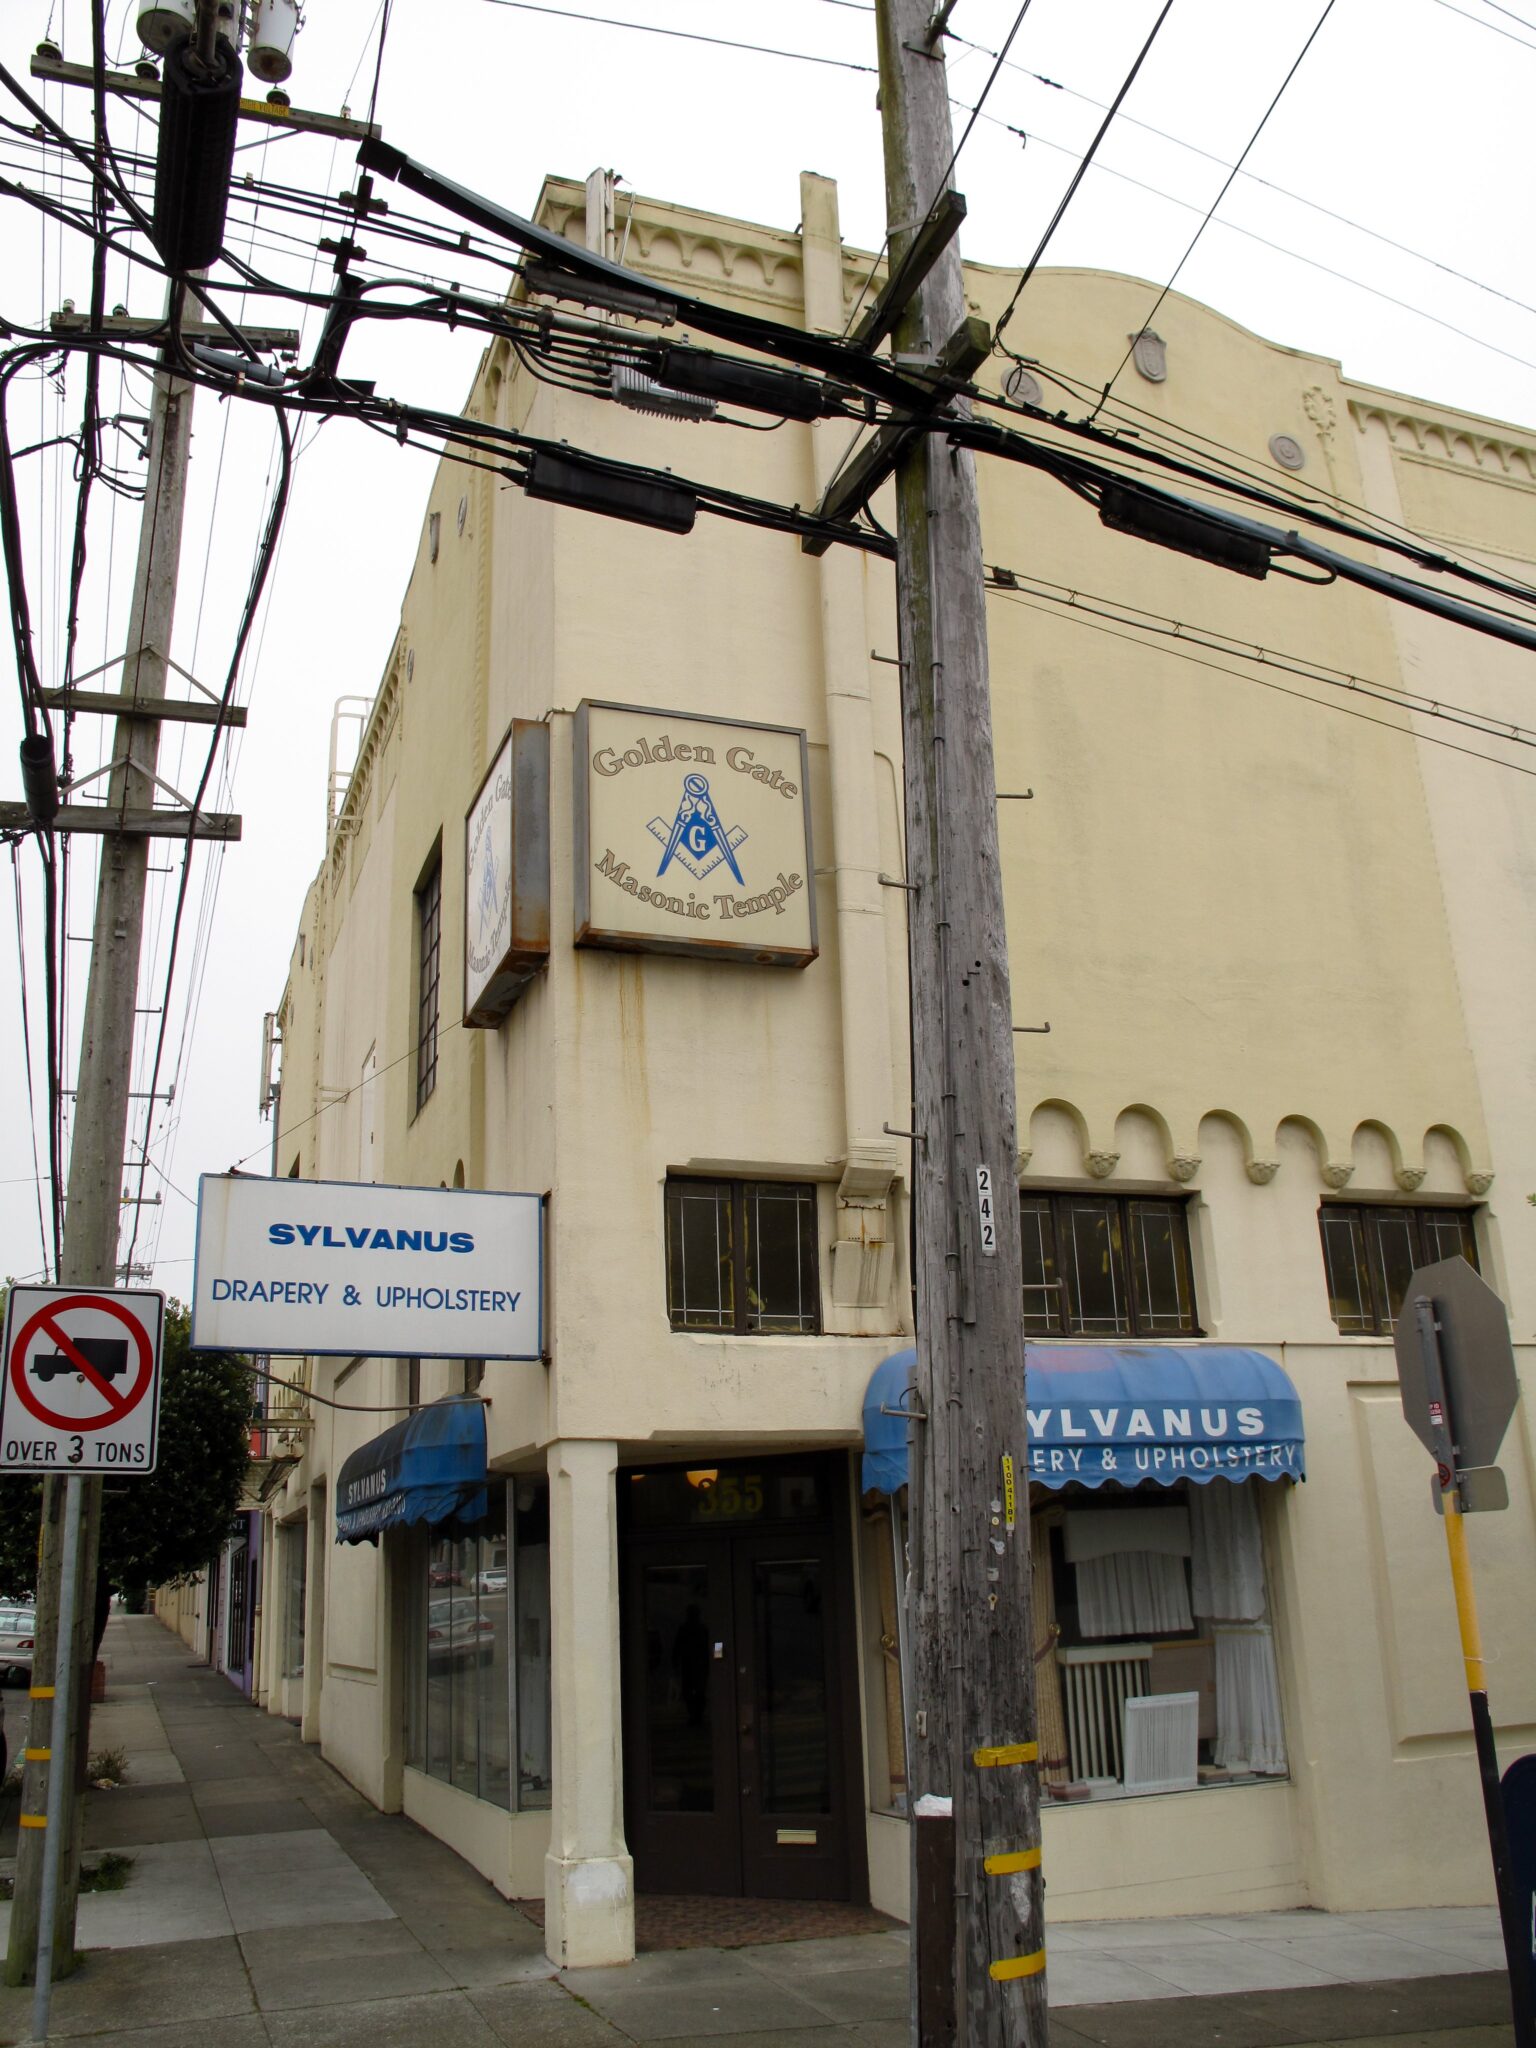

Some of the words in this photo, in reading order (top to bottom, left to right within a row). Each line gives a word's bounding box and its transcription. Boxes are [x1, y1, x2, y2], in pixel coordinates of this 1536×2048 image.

[592, 735, 717, 777] Golden
[725, 746, 798, 800] Gate
[688, 825, 706, 852] G
[594, 848, 711, 920] Masonic
[713, 871, 803, 920] Temple
[979, 1170, 993, 1246] 242
[268, 1223, 475, 1253] SYLVANUS
[212, 1278, 329, 1305] DRAPERY
[342, 1284, 362, 1306] &
[376, 1286, 521, 1312] UPHOLSTERY
[1026, 1407, 1265, 1438] YLVANUS
[6, 1440, 57, 1462] OVER
[67, 1434, 84, 1464] 3
[95, 1441, 145, 1463] TONS
[1101, 1447, 1118, 1471] &
[1135, 1444, 1296, 1471] UPHOLSTERY
[348, 1468, 386, 1505] SYLVANUS
[1005, 1457, 1015, 1523] 110041181
